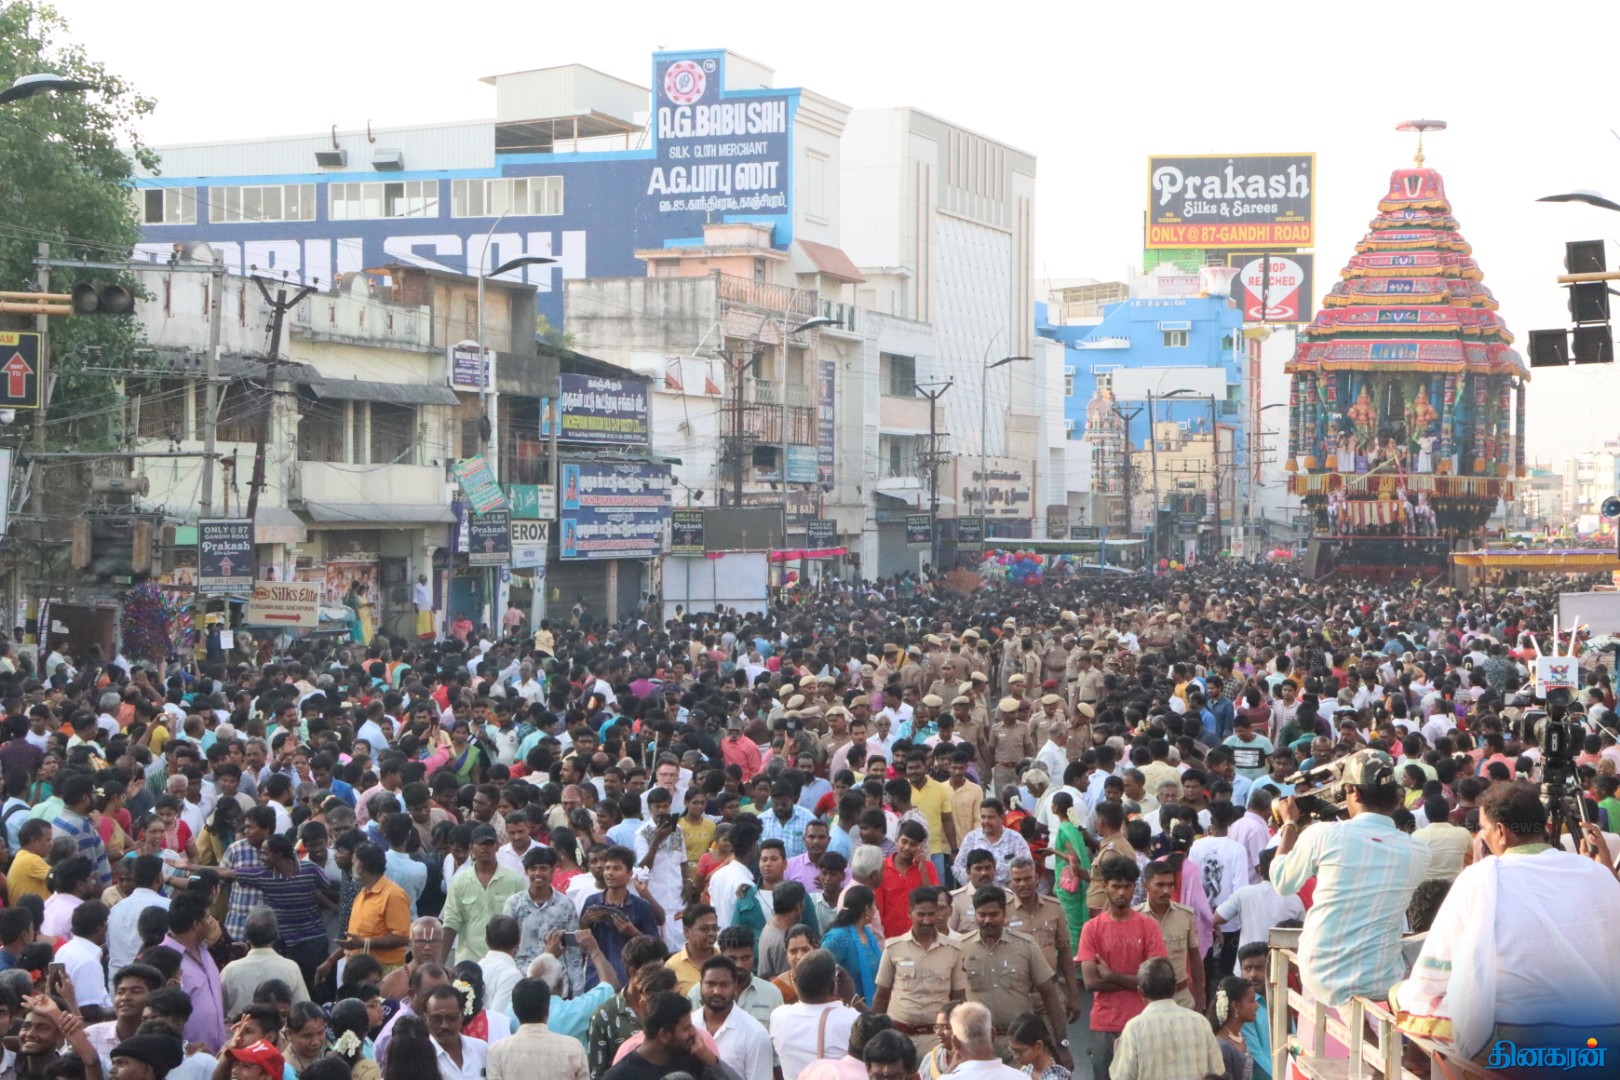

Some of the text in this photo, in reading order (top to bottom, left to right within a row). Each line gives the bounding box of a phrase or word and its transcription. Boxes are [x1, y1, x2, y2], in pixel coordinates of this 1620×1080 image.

[658, 101, 786, 139] A.G.BABU SAH
[669, 141, 768, 159] SILK CLOTH MERCHANT
[1152, 164, 1310, 206] Prakash
[1183, 200, 1278, 217] Silks & Sarees
[1151, 226, 1310, 242] ONLY @ 87-GANDHI ROAD
[1258, 262, 1286, 272] SOP
[1248, 276, 1296, 286] RECHED
[204, 526, 228, 534] ONLY
[237, 526, 248, 534] 87
[471, 525, 507, 535] Prakash
[511, 523, 547, 540] EROX
[201, 541, 250, 552] Prakash
[271, 586, 318, 602] Silks Elite
